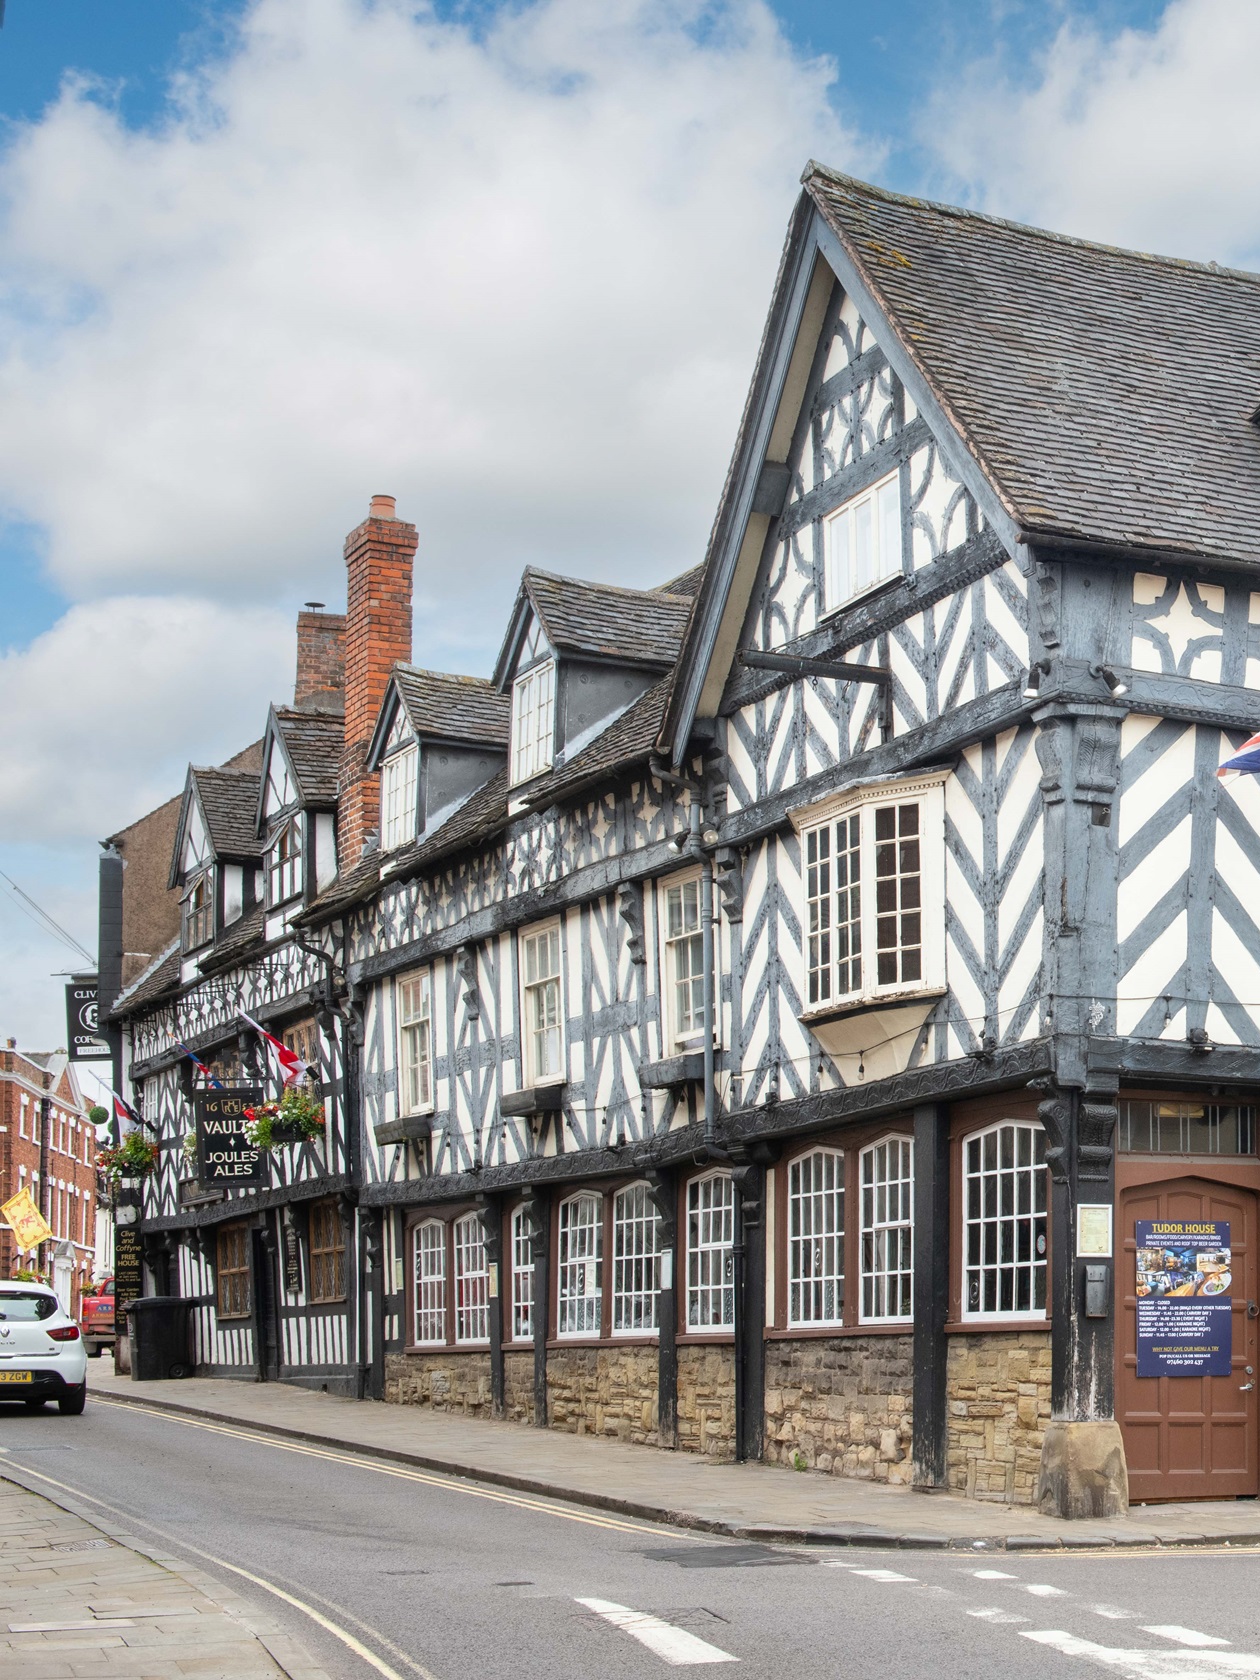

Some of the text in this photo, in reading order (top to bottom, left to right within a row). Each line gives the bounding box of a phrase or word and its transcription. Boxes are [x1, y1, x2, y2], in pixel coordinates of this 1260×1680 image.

[74, 990, 98, 998] CLIV
[206, 1102, 218, 1112] 16
[204, 1120, 249, 1134] VAULT
[214, 1164, 253, 1176] ALES
[1152, 1224, 1216, 1233] TUDOR HOUSE
[9, 1373, 28, 1381] ZGW
